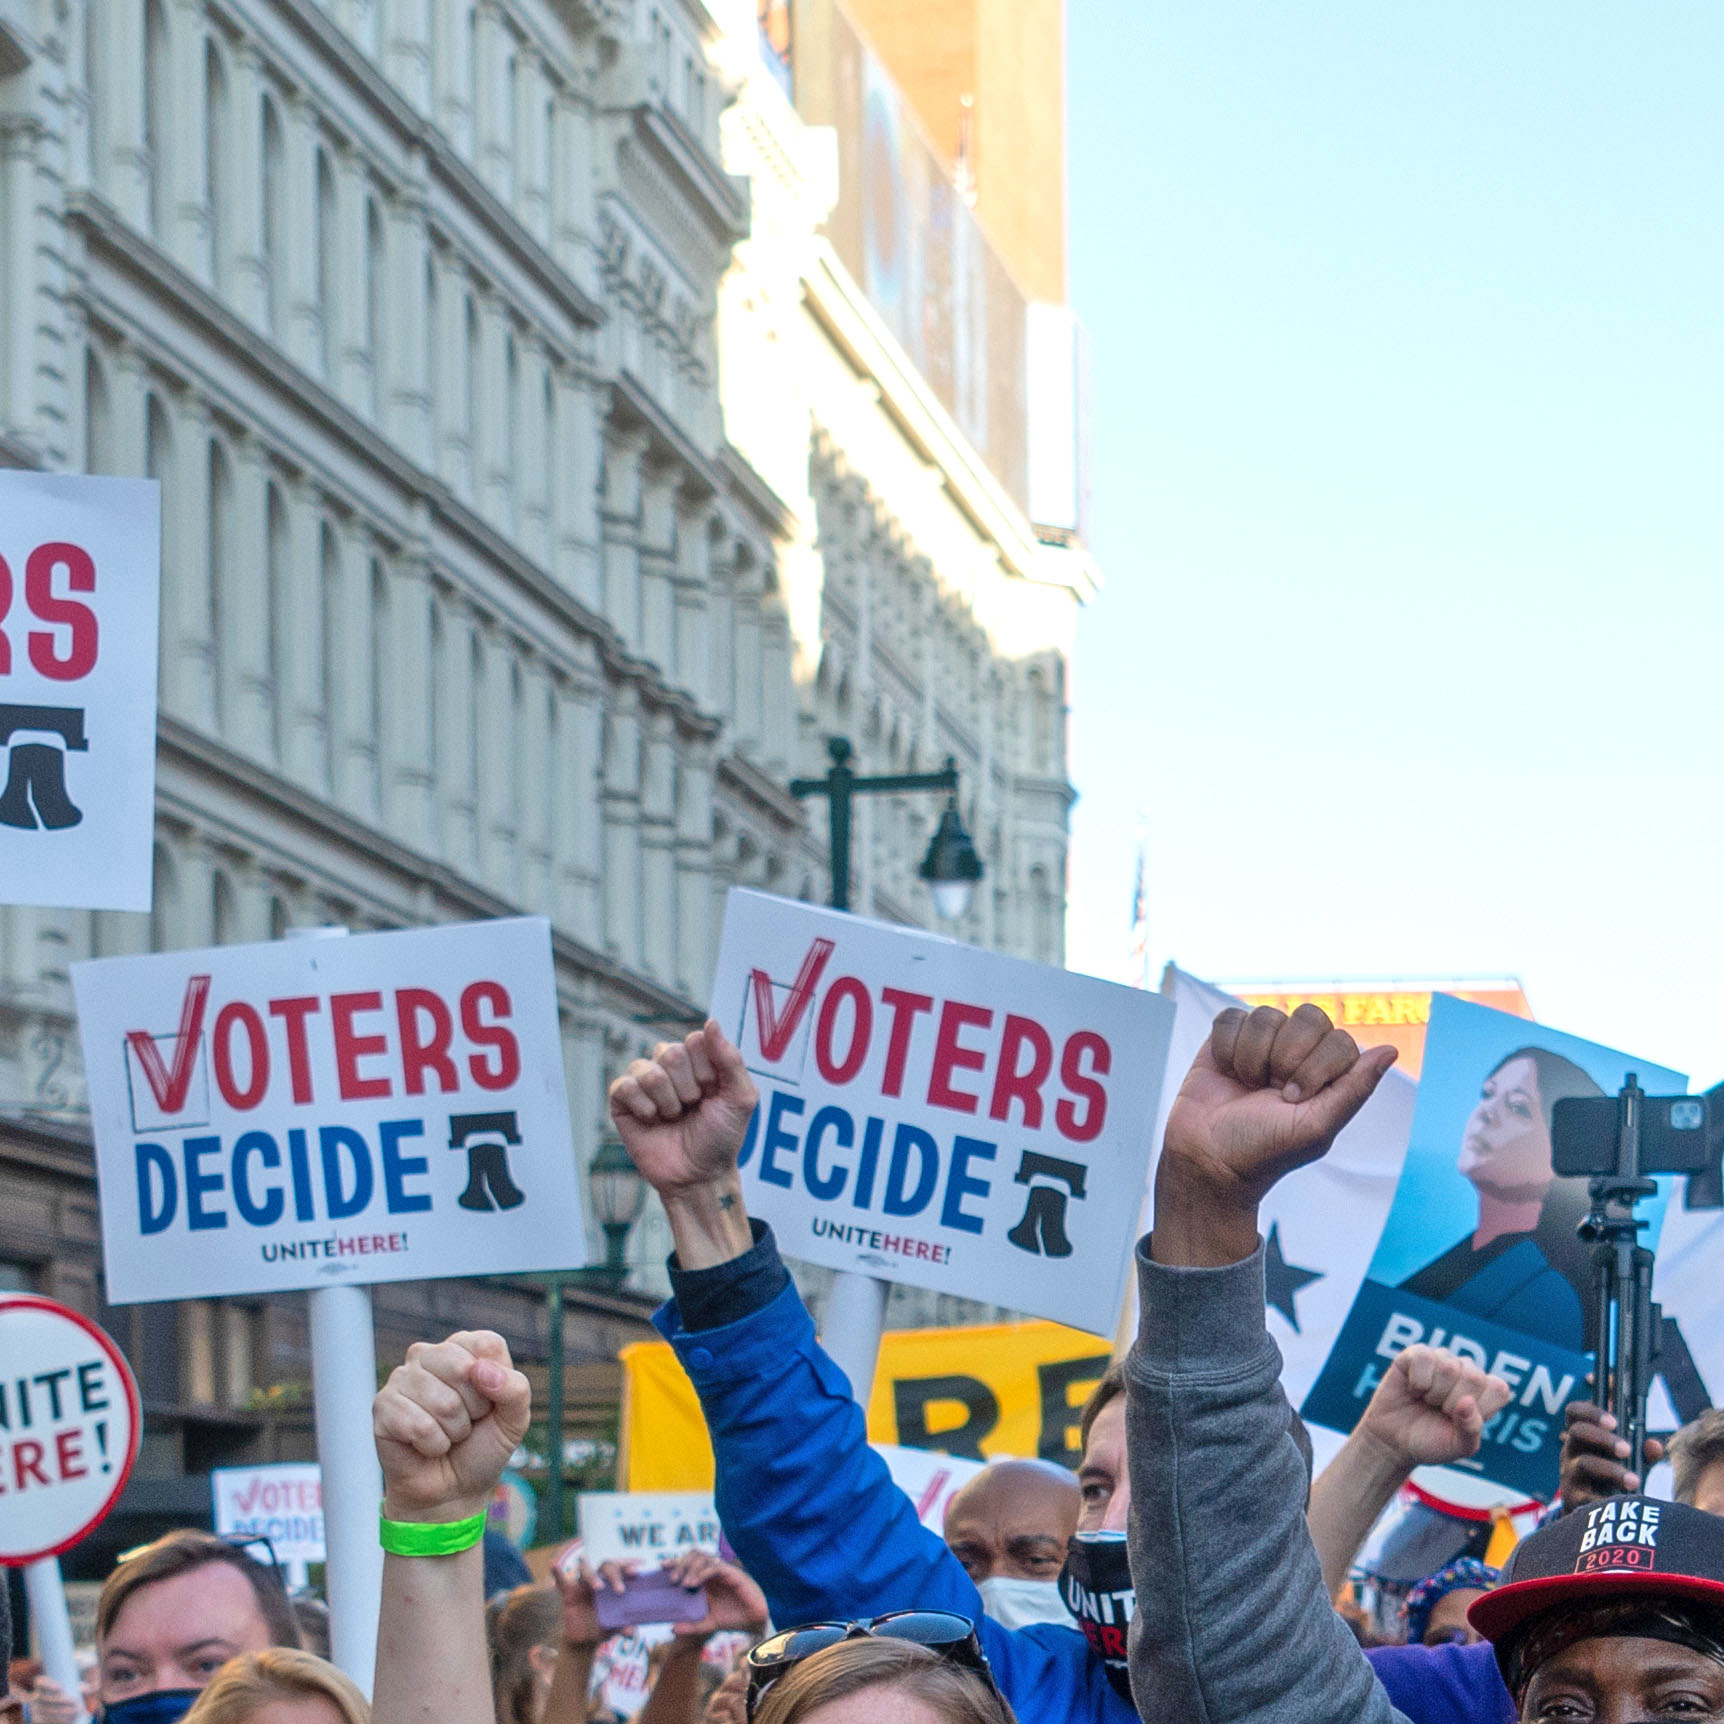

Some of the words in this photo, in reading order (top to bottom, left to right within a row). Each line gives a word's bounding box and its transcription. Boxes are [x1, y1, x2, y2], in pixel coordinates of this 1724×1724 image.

[0, 541, 99, 682] S
[125, 974, 520, 1113] VOTERS
[751, 938, 1112, 1143] VOTERS
[134, 1119, 433, 1236] DECIDE
[618, 1522, 665, 1547] WE
[1579, 1521, 1659, 1552] BACK
[1588, 1501, 1660, 1528] TAKE
[1585, 1548, 1640, 1570] 2020
